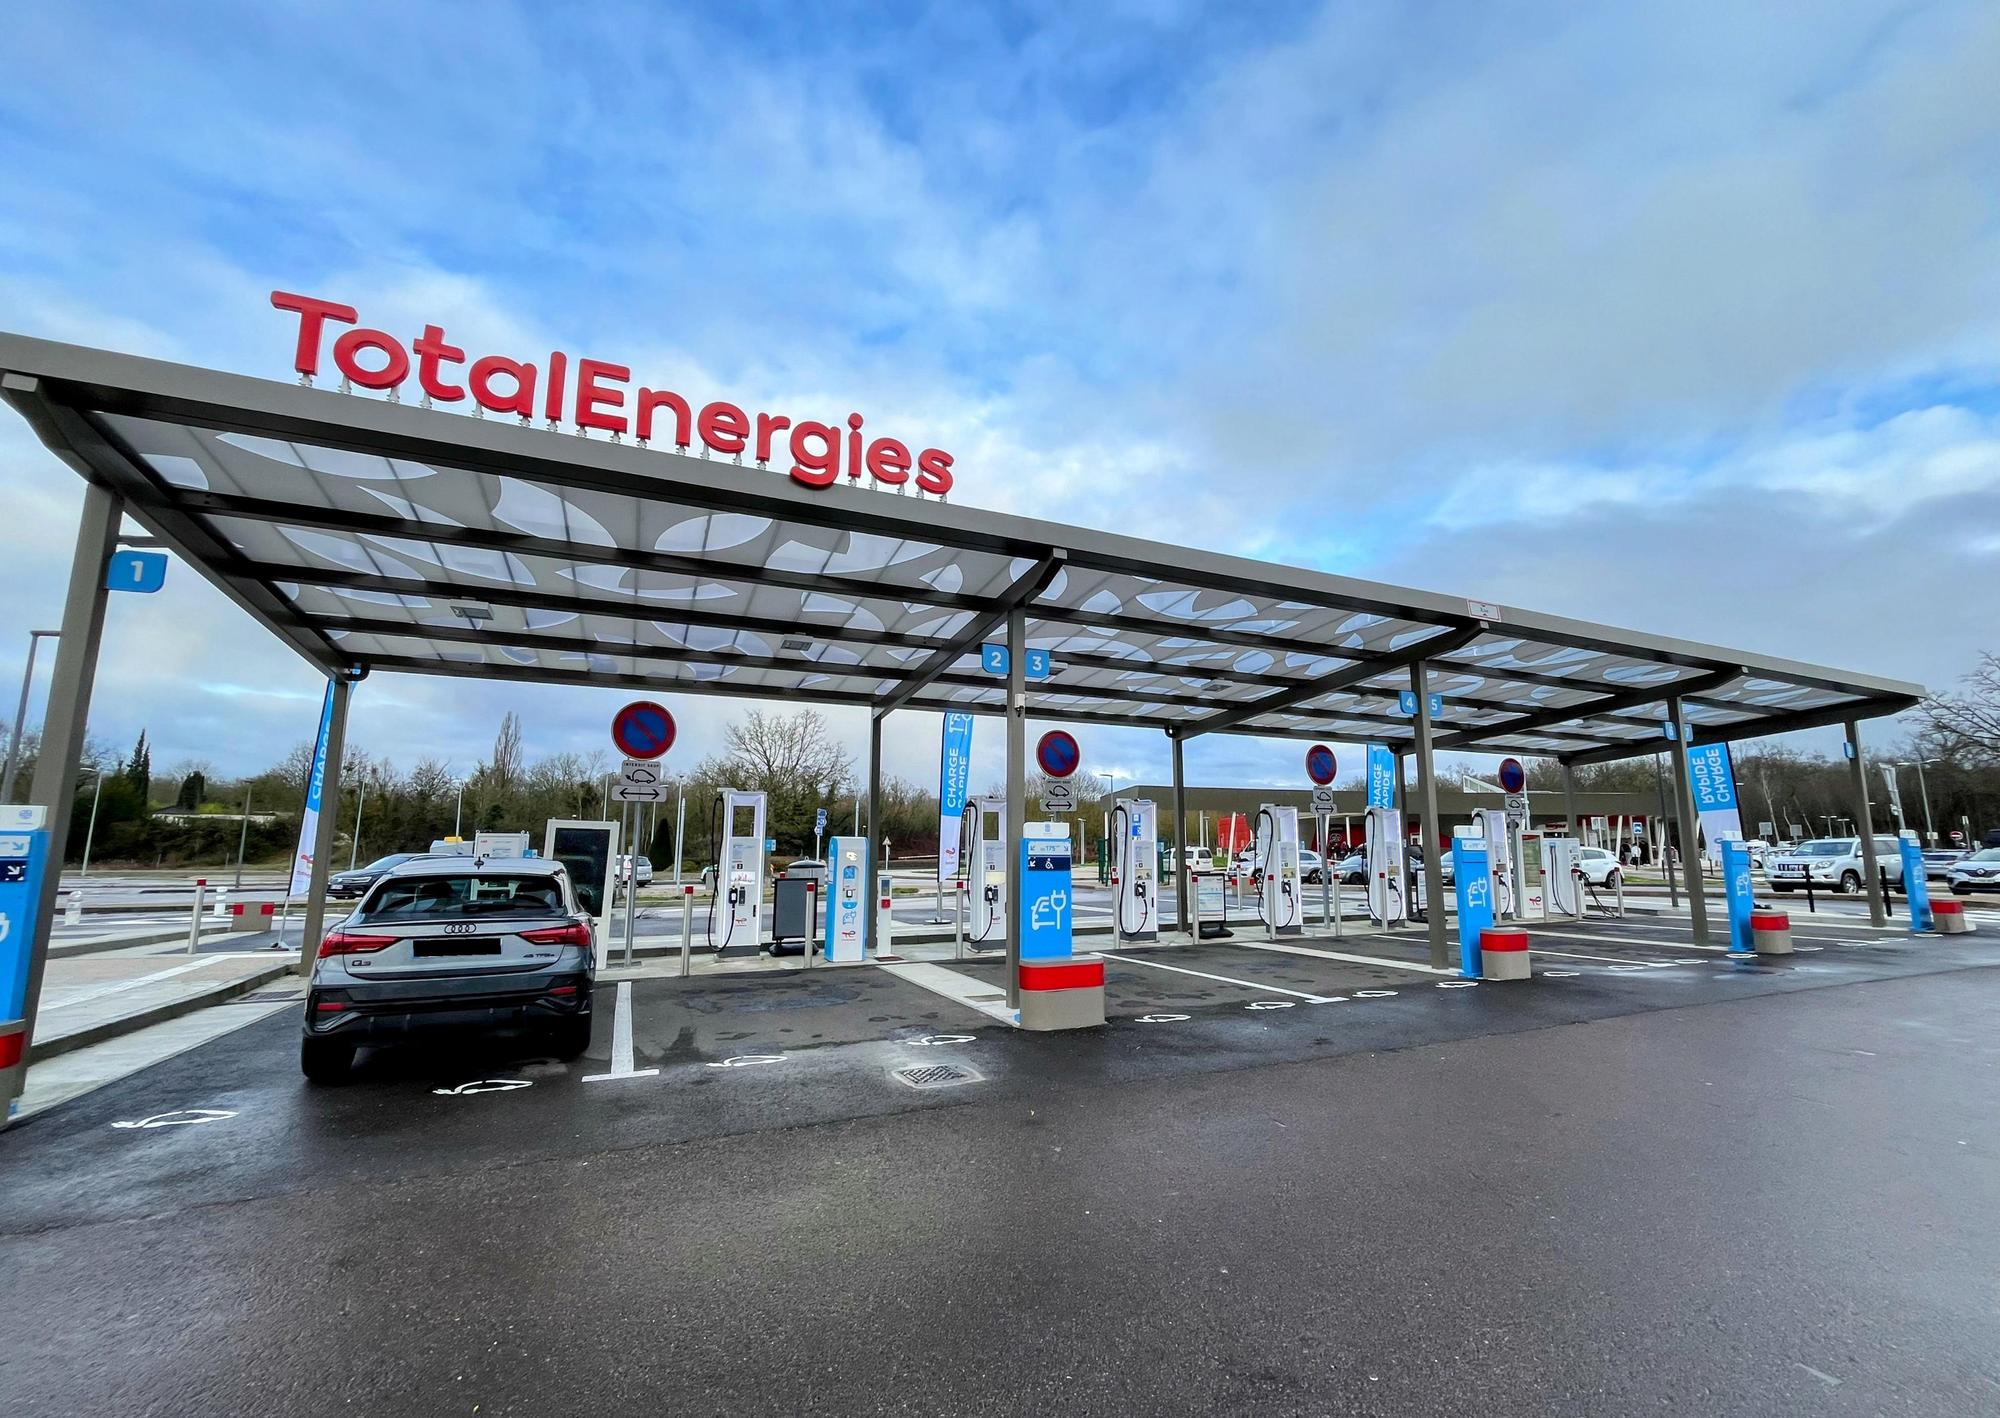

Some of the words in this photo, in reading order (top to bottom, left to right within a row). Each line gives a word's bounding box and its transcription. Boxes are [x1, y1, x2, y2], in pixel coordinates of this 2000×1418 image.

[271, 291, 954, 494] TotalEnergies
[131, 560, 144, 583] 1
[990, 651, 1002, 668] 2
[1032, 656, 1042, 671] 3
[1406, 697, 1414, 709] 4
[1431, 699, 1438, 711] 5
[947, 747, 959, 808] CHARGE
[1373, 763, 1382, 808] HARGE
